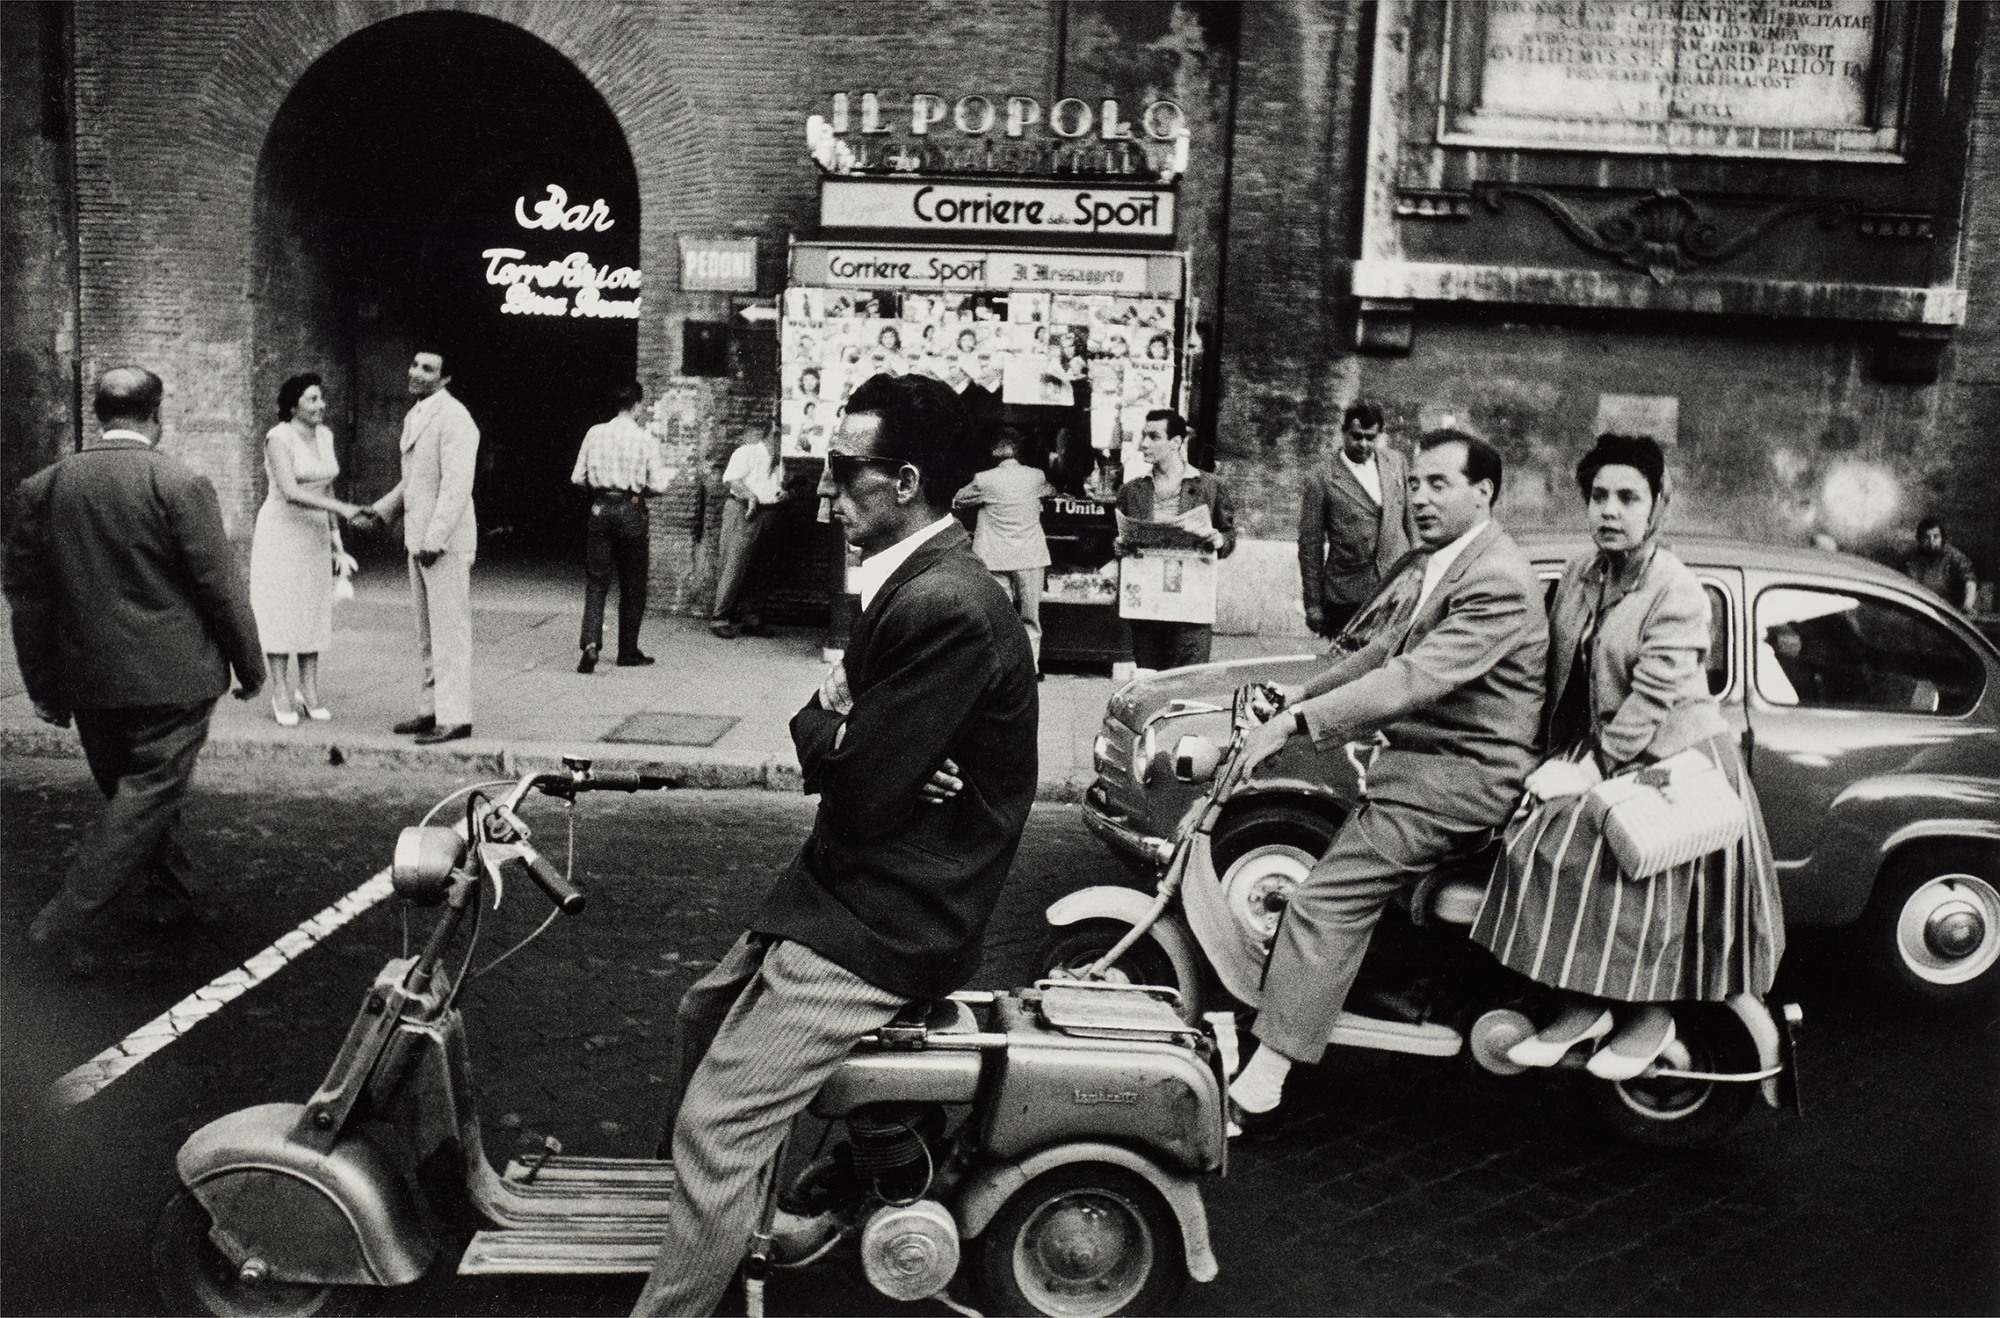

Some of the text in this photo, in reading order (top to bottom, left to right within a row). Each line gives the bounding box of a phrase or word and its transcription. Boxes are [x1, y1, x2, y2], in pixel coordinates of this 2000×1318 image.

[832, 92, 1186, 141] IL POPOLO
[515, 183, 615, 232] Bar
[913, 185, 1046, 225] Corriere
[1073, 192, 1160, 232] Sport
[829, 255, 987, 287] Corriere Sport
